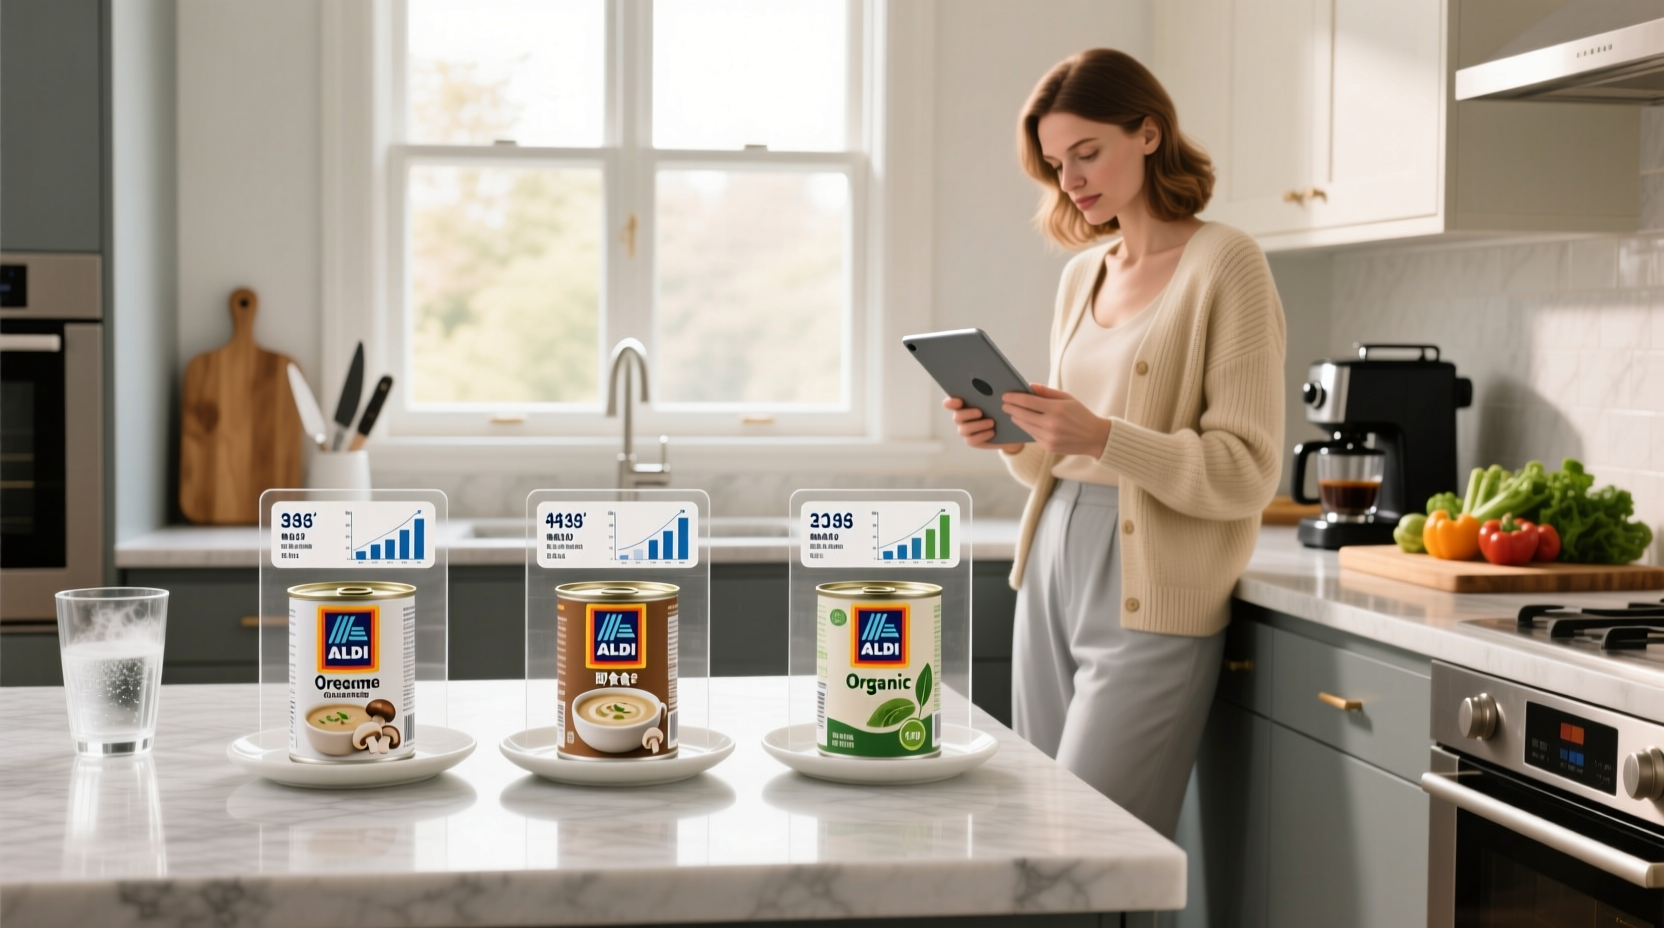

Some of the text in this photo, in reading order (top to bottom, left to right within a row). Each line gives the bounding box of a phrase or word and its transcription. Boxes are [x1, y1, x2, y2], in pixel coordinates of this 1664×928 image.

[328, 646, 368, 659] ALDI
[597, 643, 636, 656] ALDI
[861, 642, 900, 656] ALDI
[846, 673, 911, 695] Organic
